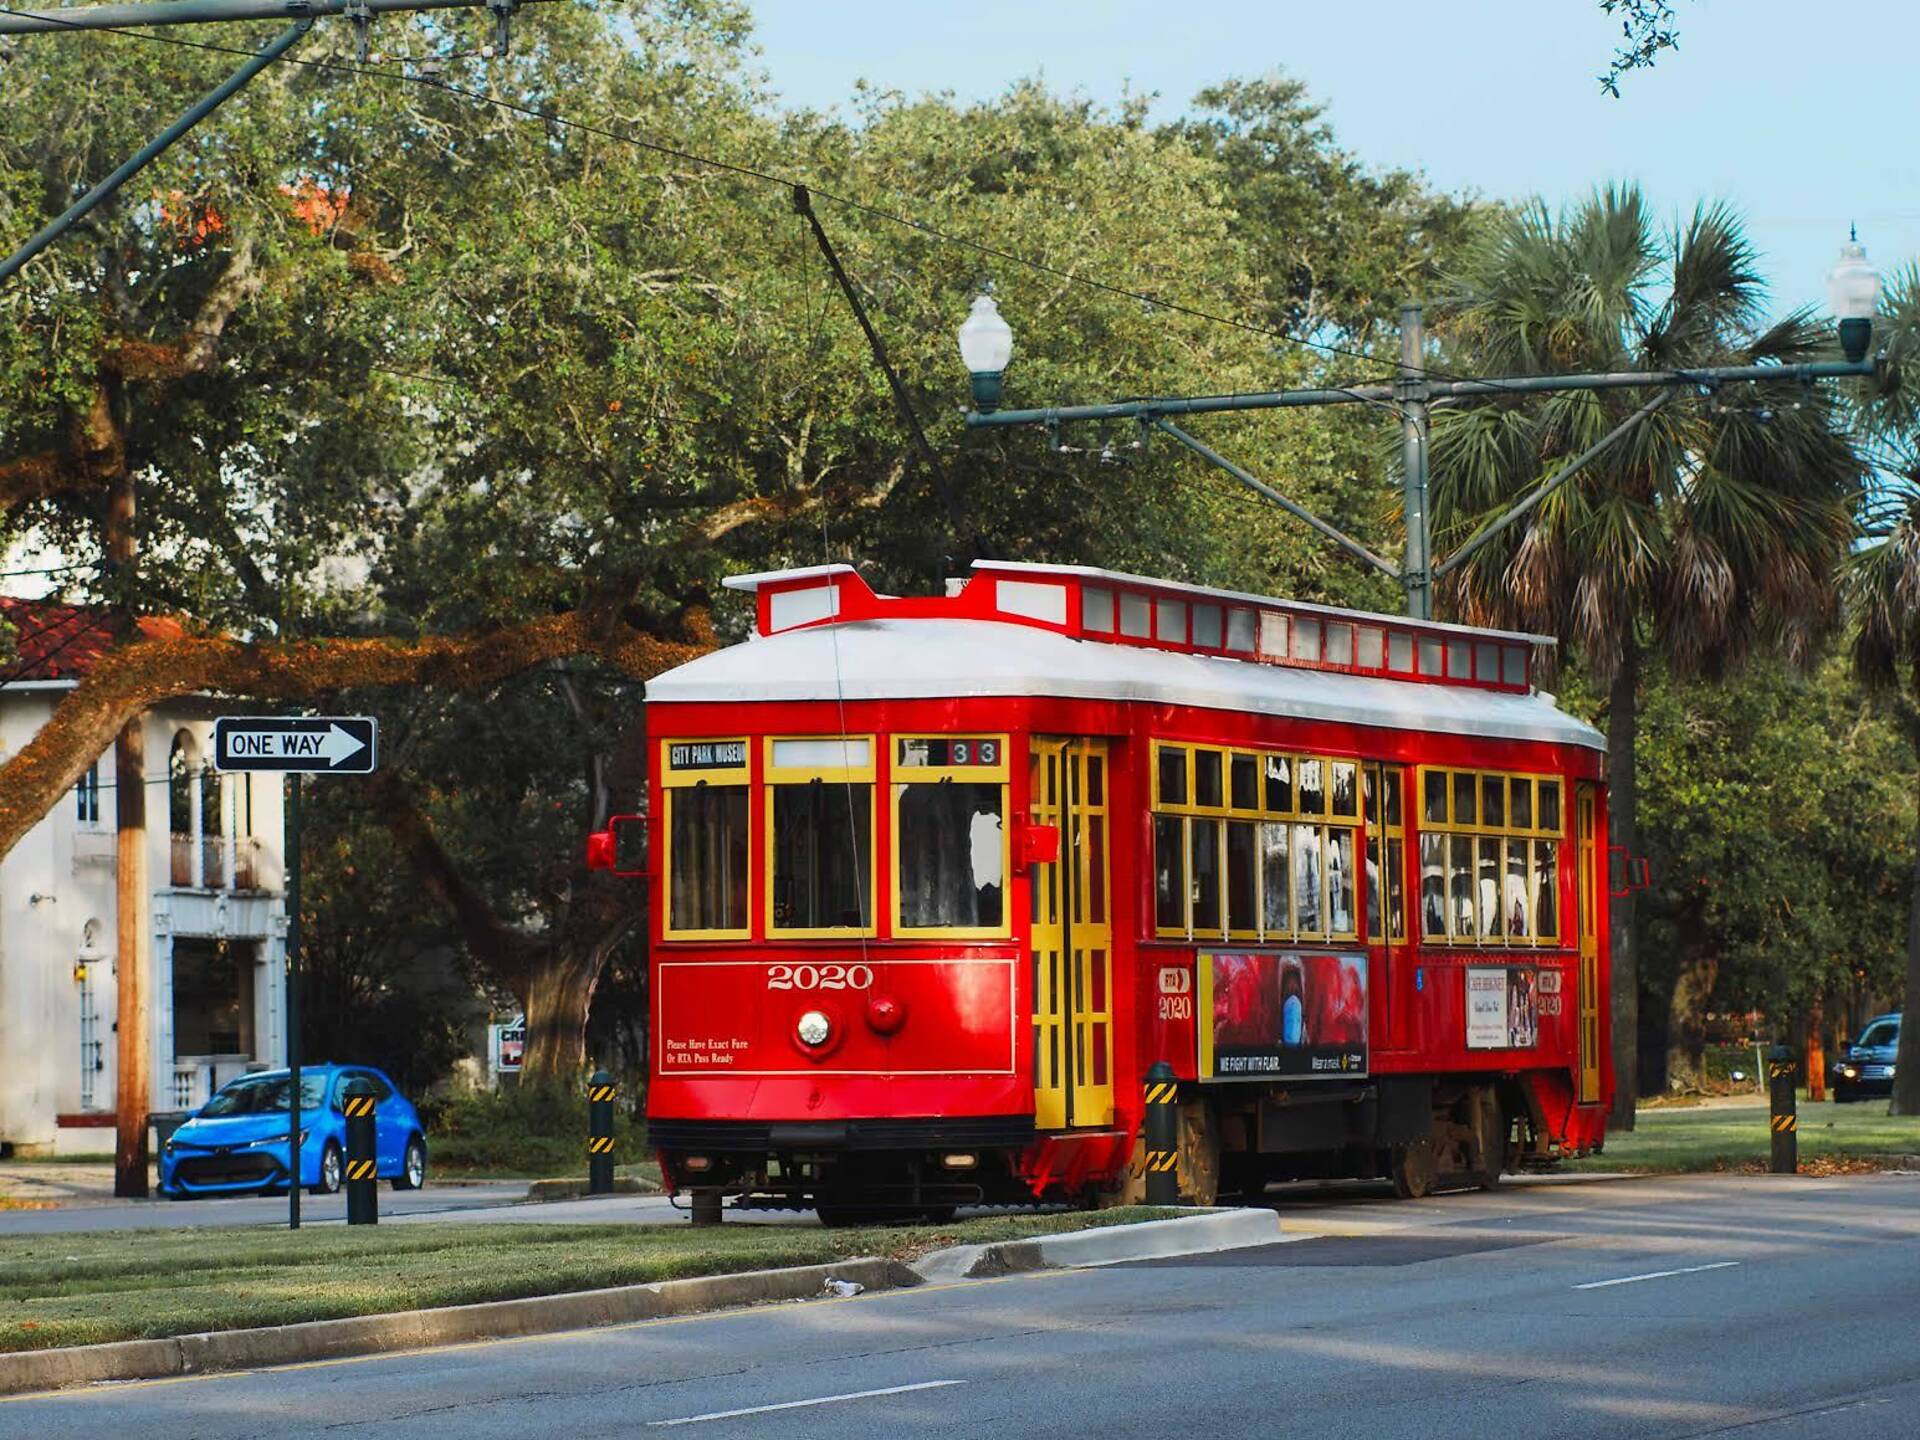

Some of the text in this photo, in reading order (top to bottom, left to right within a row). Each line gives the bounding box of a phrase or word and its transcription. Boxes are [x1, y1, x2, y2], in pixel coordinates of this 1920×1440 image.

[232, 734, 325, 755] ONE WAY
[672, 746, 690, 765] CITY
[692, 745, 713, 763] PARK
[767, 965, 874, 990] 2020
[1159, 997, 1191, 1020] 2020
[1538, 996, 1561, 1016] 2020
[666, 1038, 749, 1050] Please Have Exact Fare
[666, 1053, 734, 1064] Or RTA Pass Ready
[1220, 1056, 1230, 1072] WE
[1230, 1056, 1248, 1072] FIGHT
[1248, 1056, 1263, 1071] WITH
